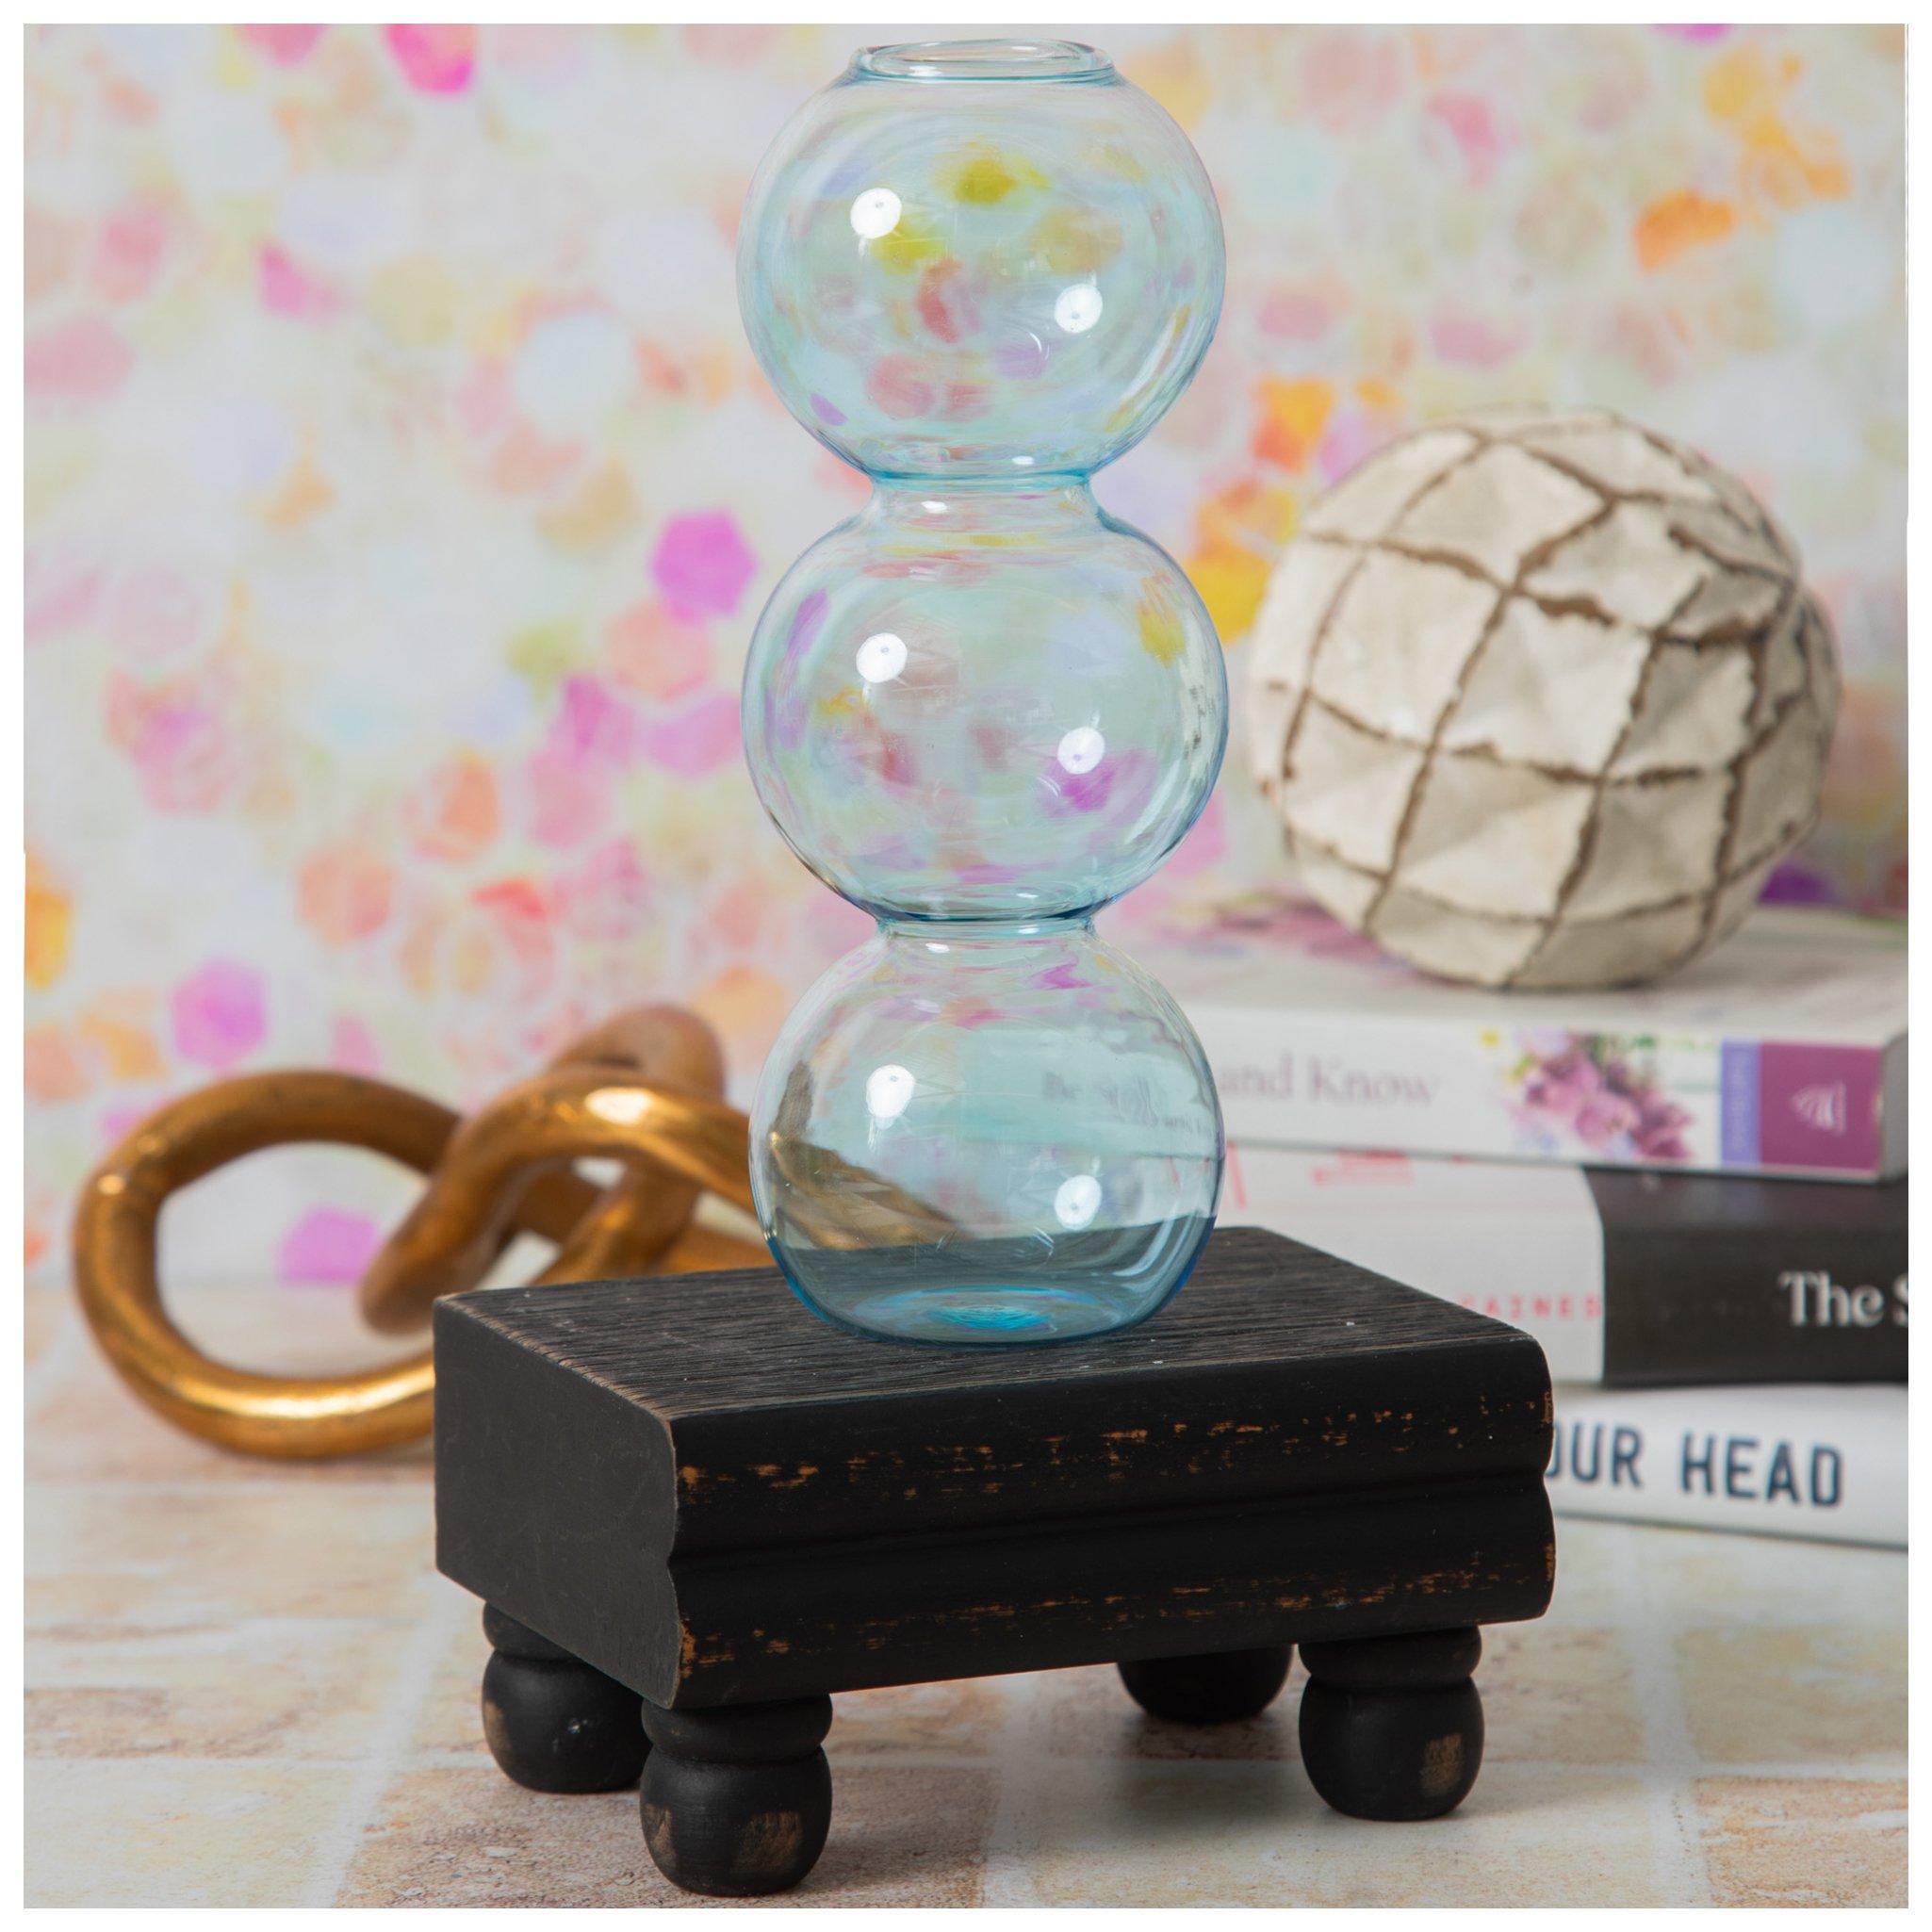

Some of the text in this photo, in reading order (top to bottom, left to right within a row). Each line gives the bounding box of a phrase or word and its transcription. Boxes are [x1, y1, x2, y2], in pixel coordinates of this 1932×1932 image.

[1219, 1049, 1293, 1100] and
[1308, 1056, 1439, 1107] Know
[1778, 1270, 1885, 1328] The
[1679, 1431, 1843, 1510] HEAD
